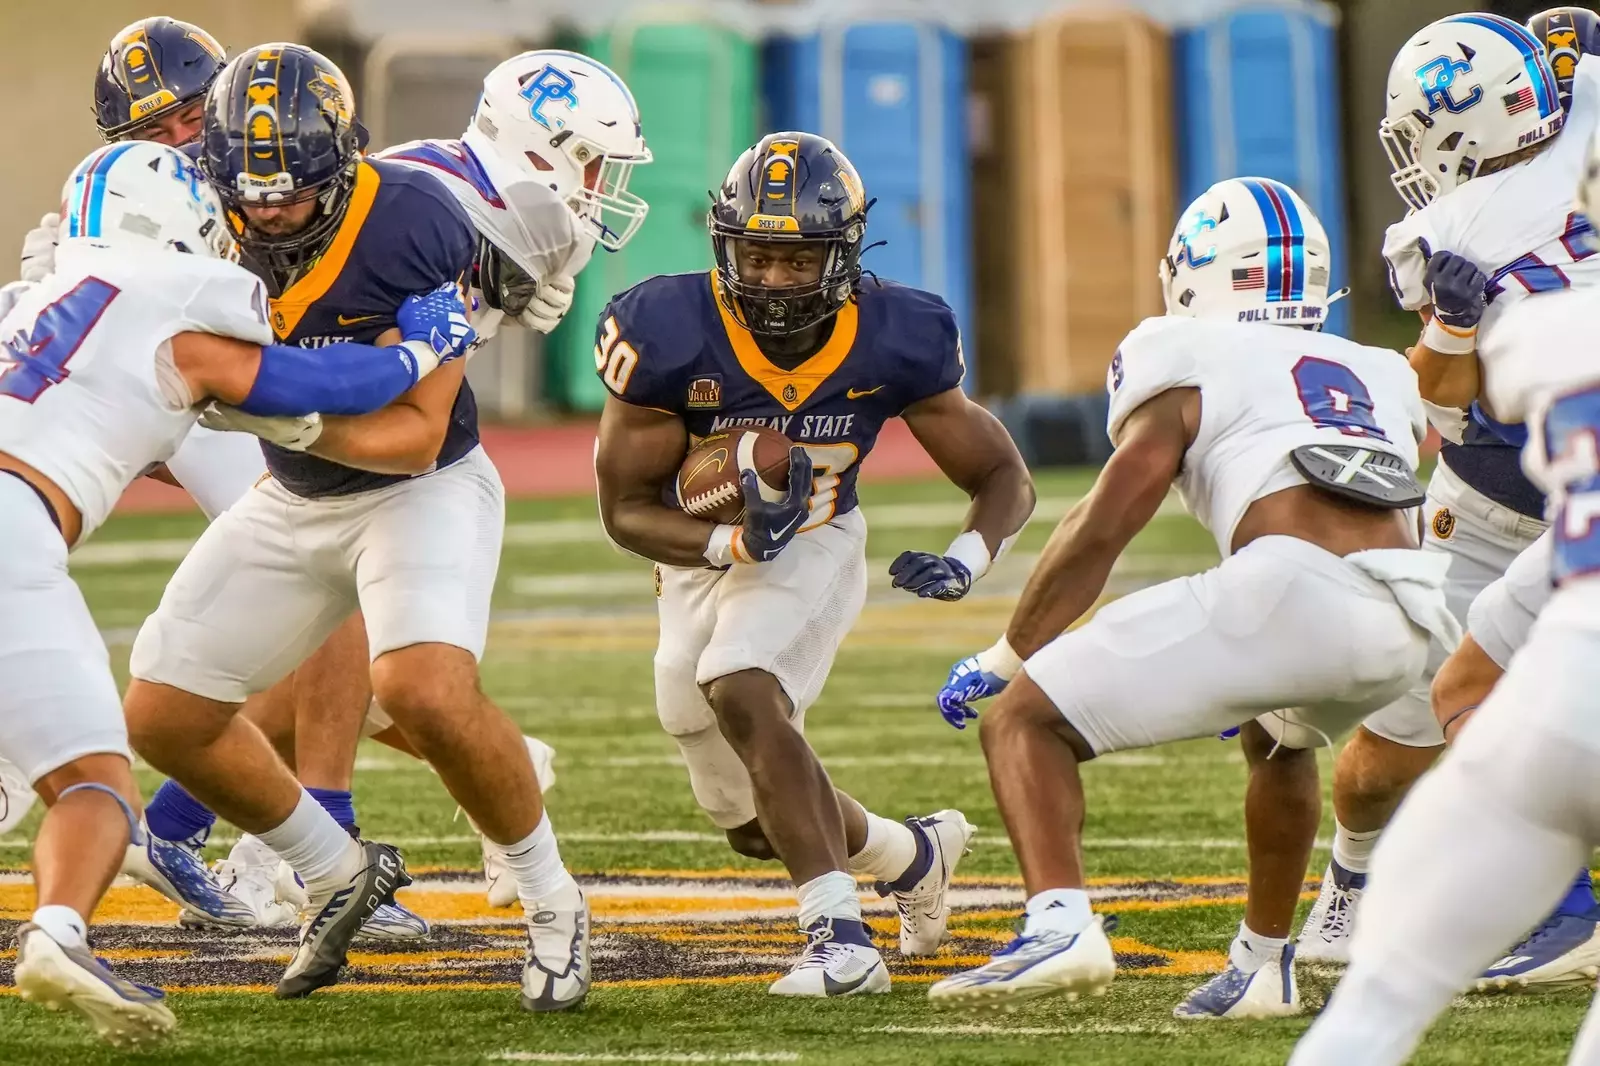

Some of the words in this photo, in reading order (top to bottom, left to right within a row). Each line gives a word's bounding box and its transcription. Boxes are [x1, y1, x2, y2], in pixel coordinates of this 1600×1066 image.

[1414, 54, 1484, 115] PC
[518, 63, 579, 132] PC
[1518, 126, 1545, 148] PULL
[1238, 308, 1269, 323] PULL
[1276, 306, 1298, 320] THE
[298, 335, 355, 350] STA
[593, 315, 640, 396] 30
[687, 386, 721, 402] VALLEY
[800, 413, 856, 439] STATE
